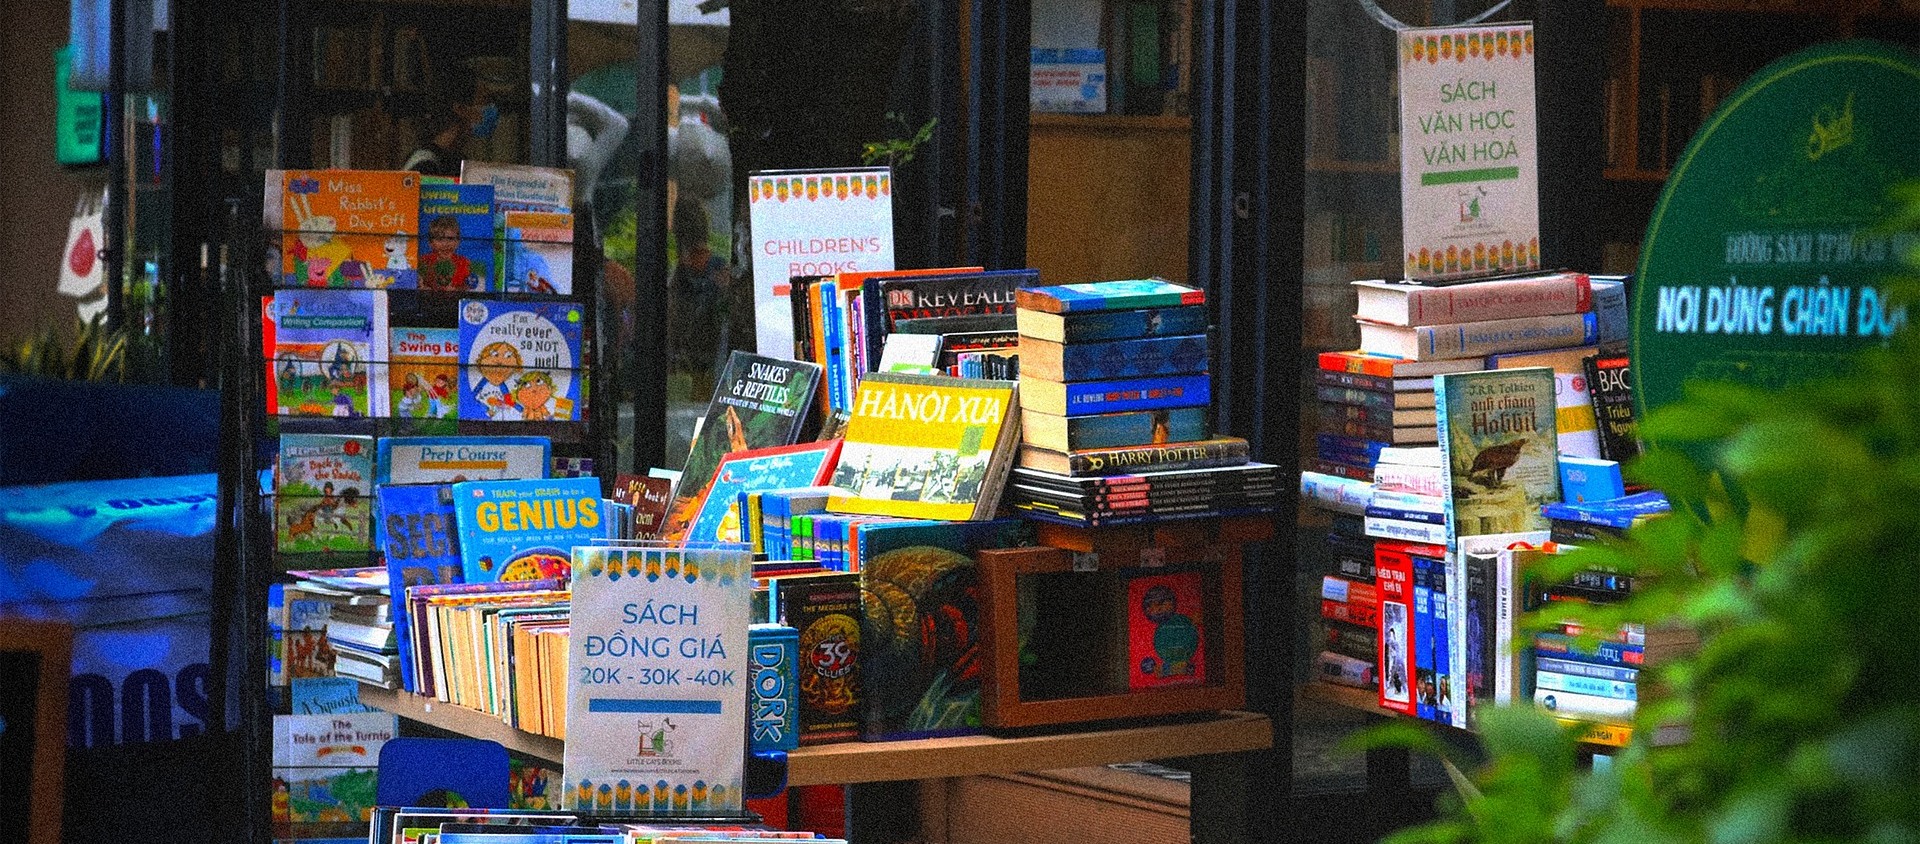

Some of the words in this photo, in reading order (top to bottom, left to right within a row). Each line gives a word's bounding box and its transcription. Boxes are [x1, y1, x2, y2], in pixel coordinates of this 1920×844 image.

[1440, 78, 1496, 103] SÁCH
[1419, 110, 1462, 135] VĂN
[1470, 109, 1516, 136] HỌC
[1423, 141, 1466, 166] VĂN
[329, 178, 362, 193] Miss
[339, 197, 397, 211] Rabbit's
[350, 215, 373, 229] Day
[381, 214, 405, 227] Off
[764, 237, 881, 256] CHILDREN'S
[789, 261, 858, 277] BOOKS
[919, 289, 1016, 308] REVEALE
[283, 318, 311, 328] Writing
[312, 318, 364, 328] Composition
[513, 314, 528, 323] I'm
[407, 332, 426, 340] The
[490, 324, 522, 337] really
[525, 327, 552, 339] ever
[400, 341, 440, 355] Swing
[445, 341, 458, 352] Bo
[521, 341, 532, 350] so
[535, 341, 559, 352] NOT
[748, 362, 790, 384] SNAKES
[742, 381, 790, 404] REPTILES
[1498, 383, 1535, 394] Tolkien
[1472, 412, 1537, 437] Hobbit
[420, 447, 453, 462] Prep
[457, 447, 507, 461] Course
[1108, 452, 1152, 467] HARRY
[1159, 448, 1208, 463] POTTER
[476, 497, 599, 532] GENIUS
[622, 599, 699, 626] SÁCH
[584, 632, 671, 658] ĐỒNG
[679, 634, 726, 660] GIÁ
[819, 641, 851, 666] 39
[581, 667, 620, 685] 20K
[640, 668, 679, 686] 30K
[817, 665, 851, 679] CLUES
[752, 642, 787, 743] DORK
[333, 720, 352, 729] The
[293, 735, 316, 744] Tale
[320, 733, 332, 743] of
[334, 732, 352, 742] the
[356, 731, 392, 743] Turnip
